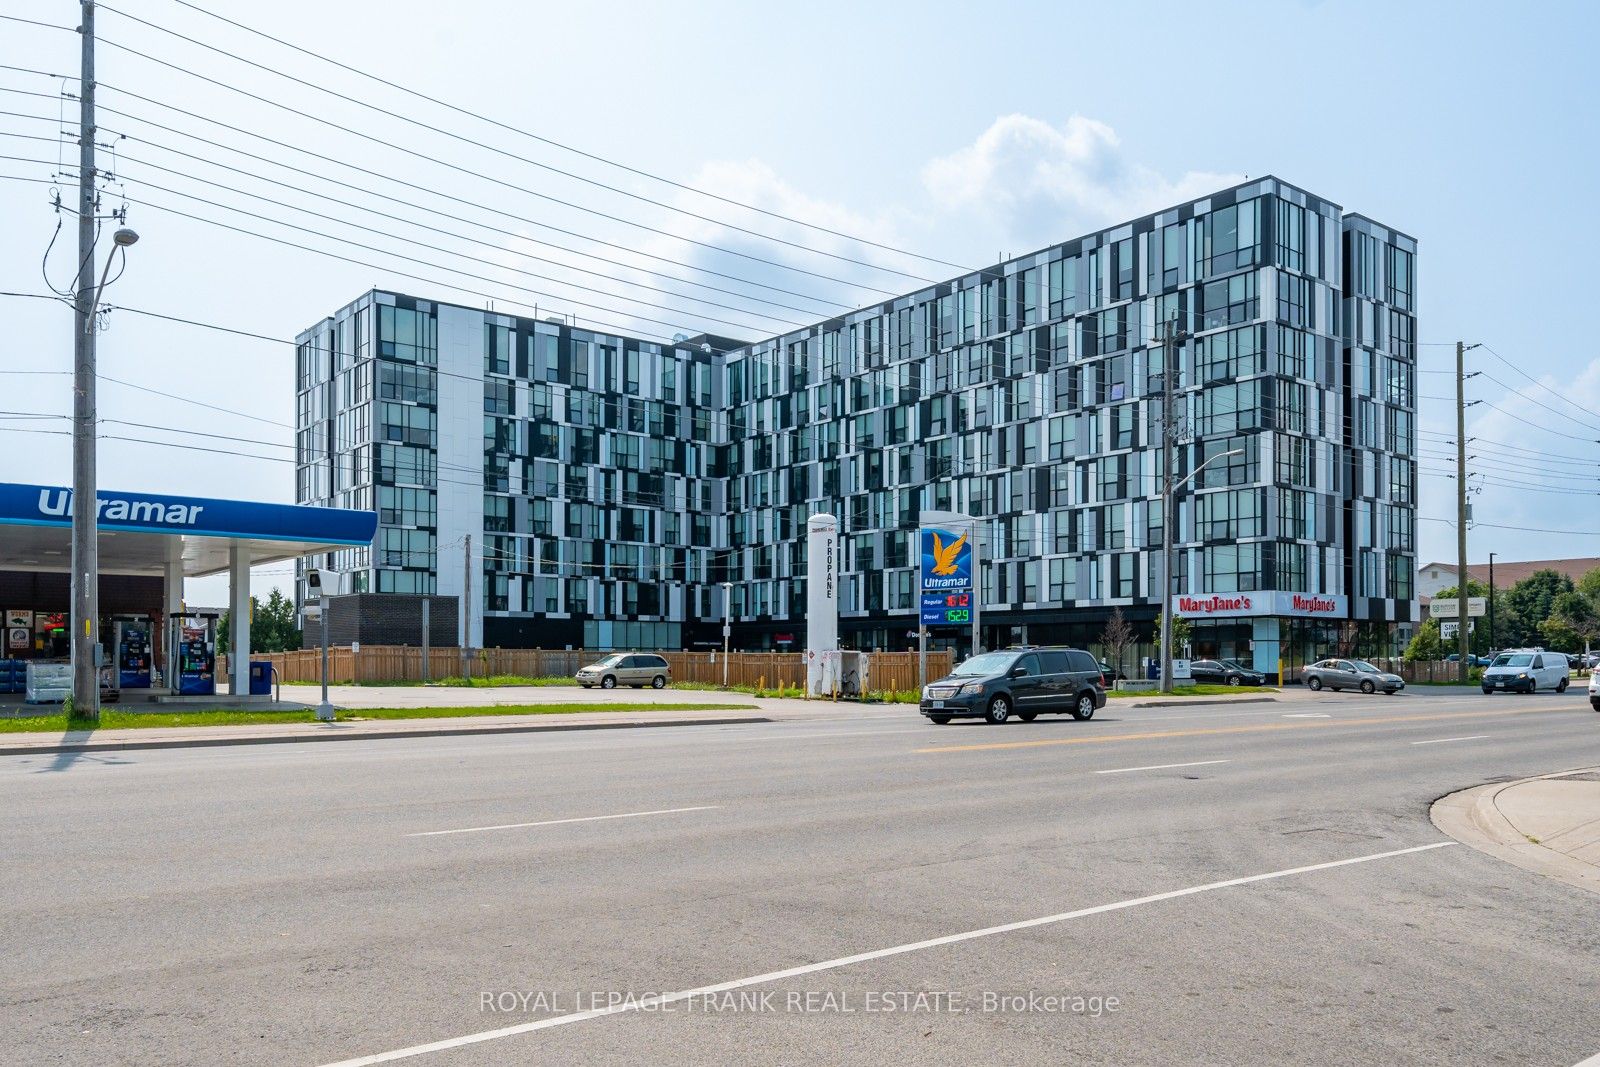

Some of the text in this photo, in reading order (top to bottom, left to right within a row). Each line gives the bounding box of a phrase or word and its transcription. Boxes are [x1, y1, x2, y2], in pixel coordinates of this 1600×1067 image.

[924, 577, 969, 588] Ultramar
[1179, 595, 1251, 613] MaryJane's
[1293, 595, 1336, 612] MaryJane's
